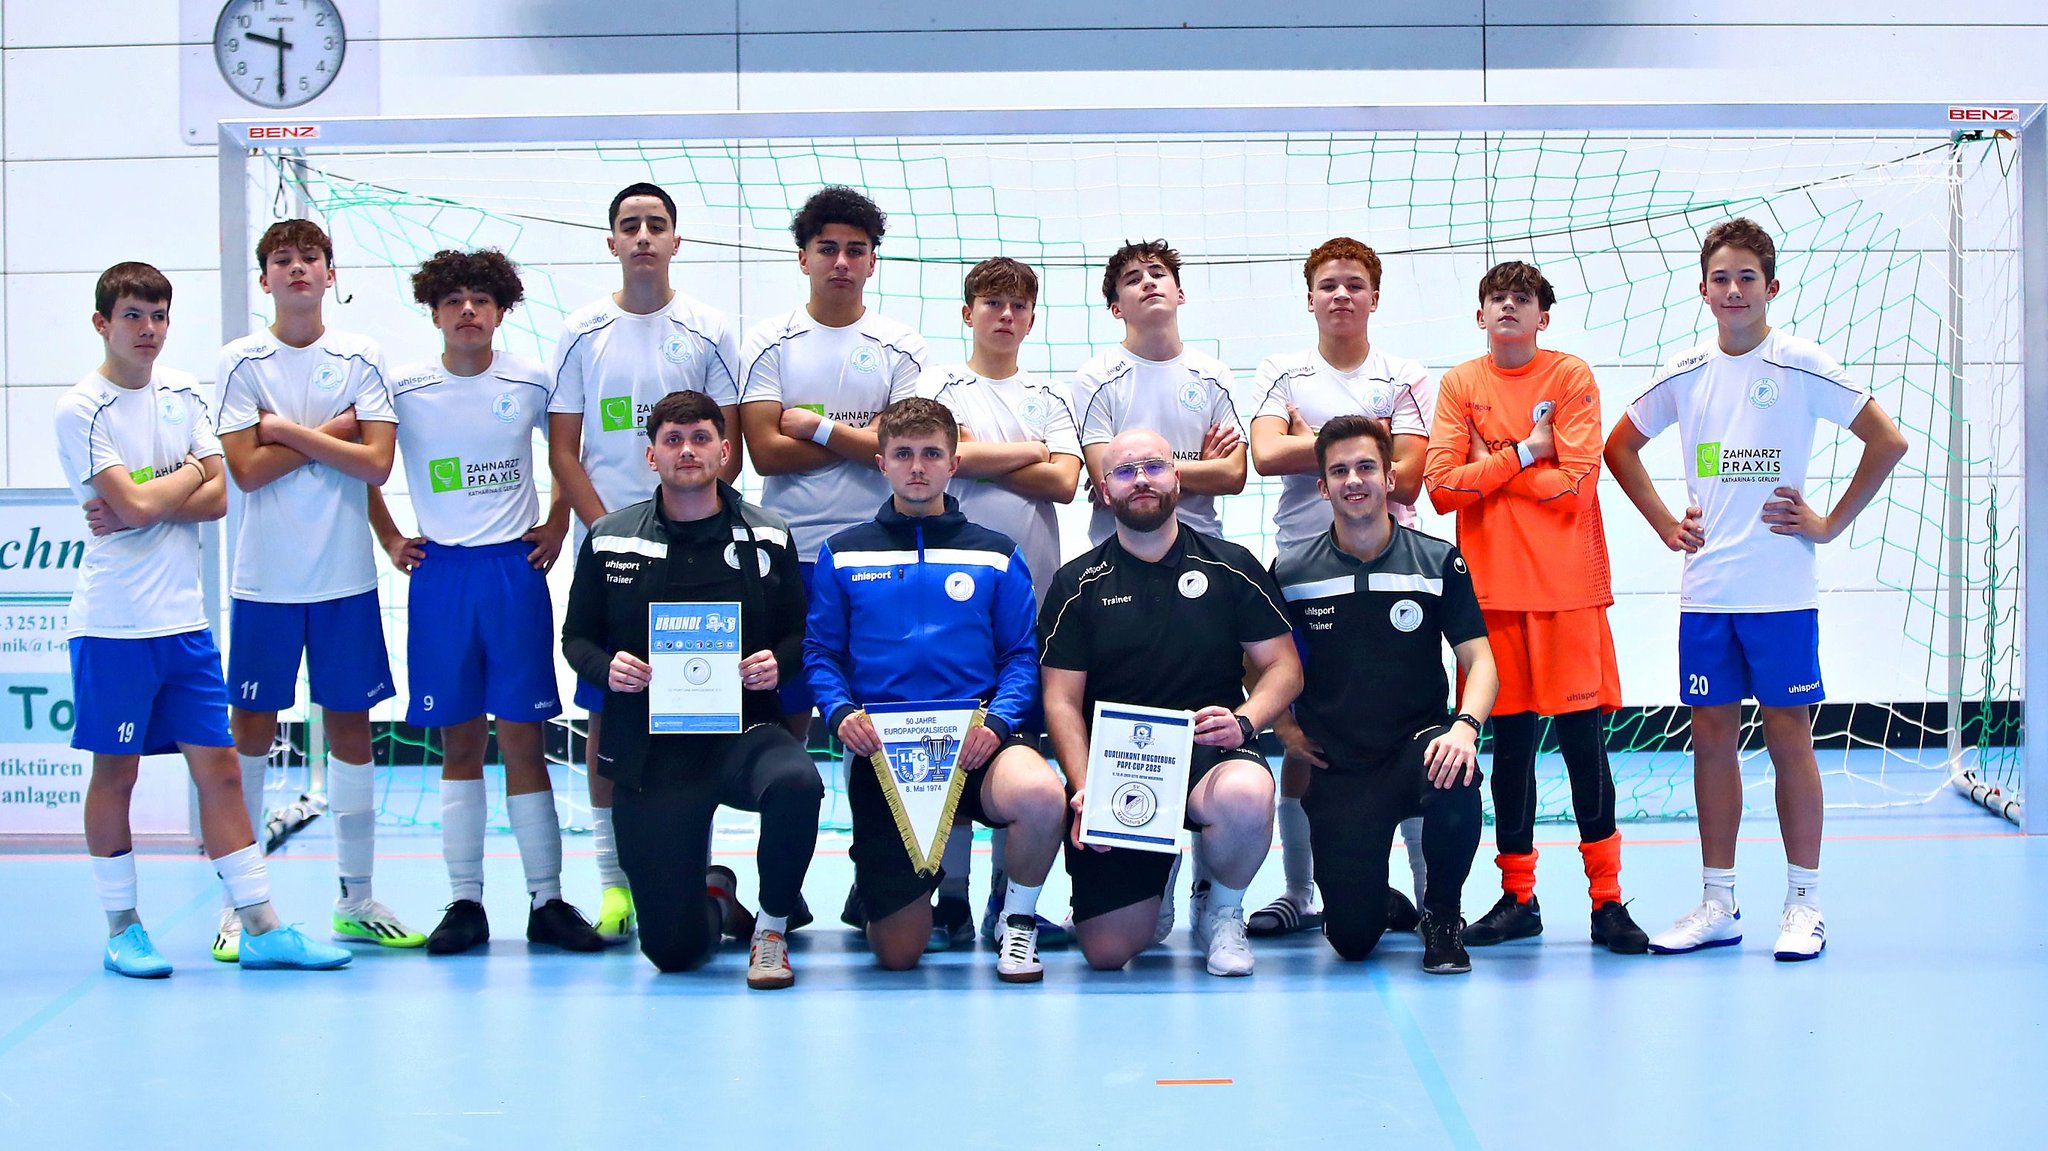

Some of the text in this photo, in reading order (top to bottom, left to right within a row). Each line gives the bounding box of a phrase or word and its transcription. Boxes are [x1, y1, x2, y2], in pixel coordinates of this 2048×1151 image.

[236, 15, 251, 29] 10
[315, 13, 325, 27] 2
[228, 38, 239, 52] 9
[323, 36, 333, 51] 3
[237, 61, 248, 76] 8
[315, 60, 325, 73] 4
[254, 77, 265, 92] 7
[299, 76, 309, 91] 5
[1949, 109, 2014, 121] BENZ
[249, 126, 315, 139] BENZ
[398, 374, 436, 387] uhlsport
[1722, 448, 1782, 459] ZAHNARZT
[466, 458, 520, 474] ZAHNARZT
[1722, 460, 1781, 472] PRAXIS
[467, 469, 521, 487] PRAXIS
[605, 560, 640, 571] uhlsport
[606, 573, 634, 584] Trainer
[851, 570, 892, 582] uhlsport
[1101, 594, 1133, 607] Trainer
[1304, 605, 1335, 617] uhlsport
[1309, 621, 1333, 631] Trainer
[240, 680, 259, 700] 11
[1689, 673, 1709, 696] 20
[1788, 680, 1821, 694] uhlsport
[423, 695, 434, 711] 9
[905, 716, 937, 725] 50 JAHRE
[117, 721, 135, 744] 19
[883, 725, 958, 736] EUROPAPOKALSIEGER
[1104, 749, 1177, 765] QUALIFIKANT MAGDEBURG
[1116, 760, 1162, 773] PAPE-CUP 2025
[926, 784, 942, 792] 1974
